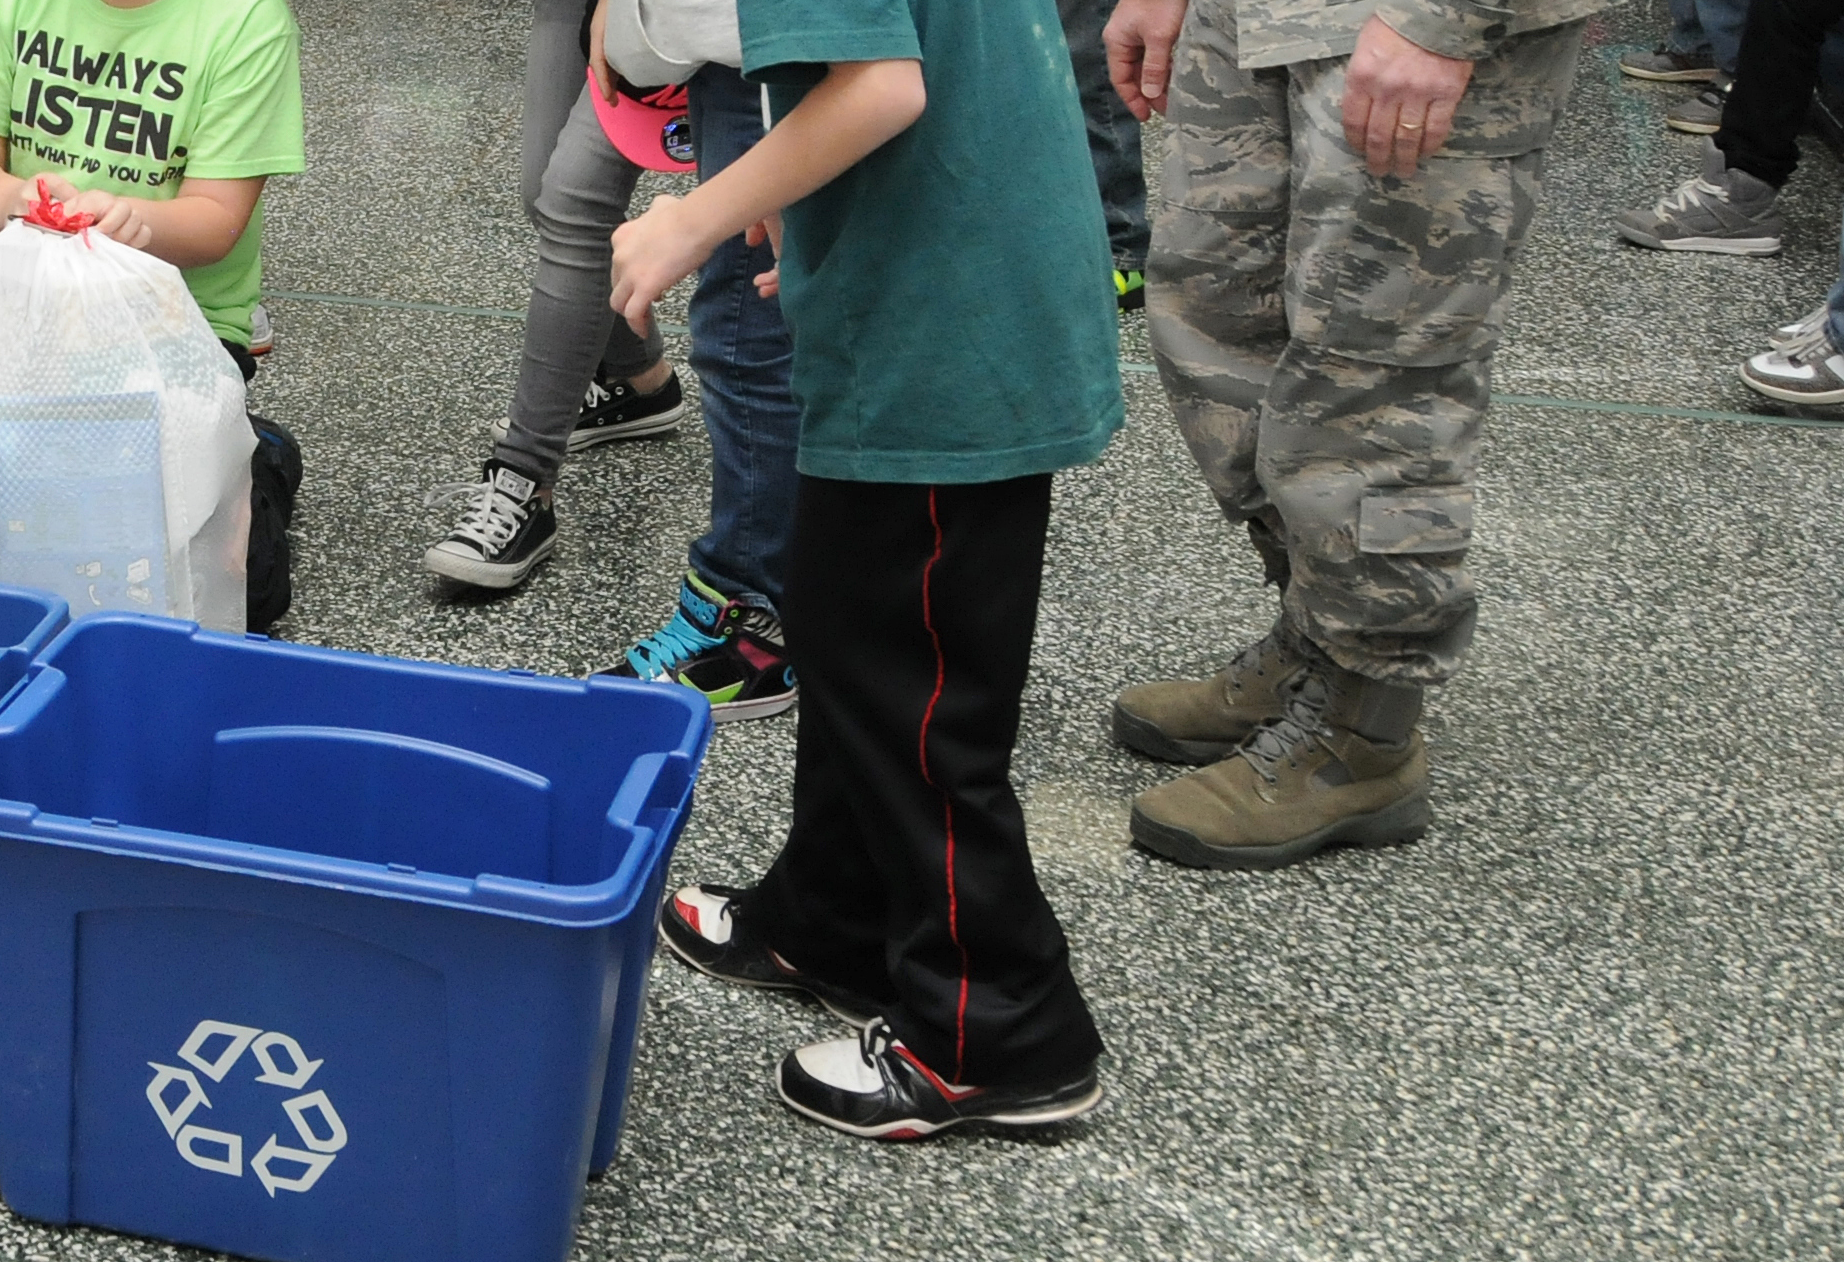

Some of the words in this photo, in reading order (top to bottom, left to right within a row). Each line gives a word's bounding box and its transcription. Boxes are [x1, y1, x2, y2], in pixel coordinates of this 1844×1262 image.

[21, 29, 188, 102] ALWAYS
[35, 142, 80, 169] WHAT
[108, 164, 142, 183] YOU
